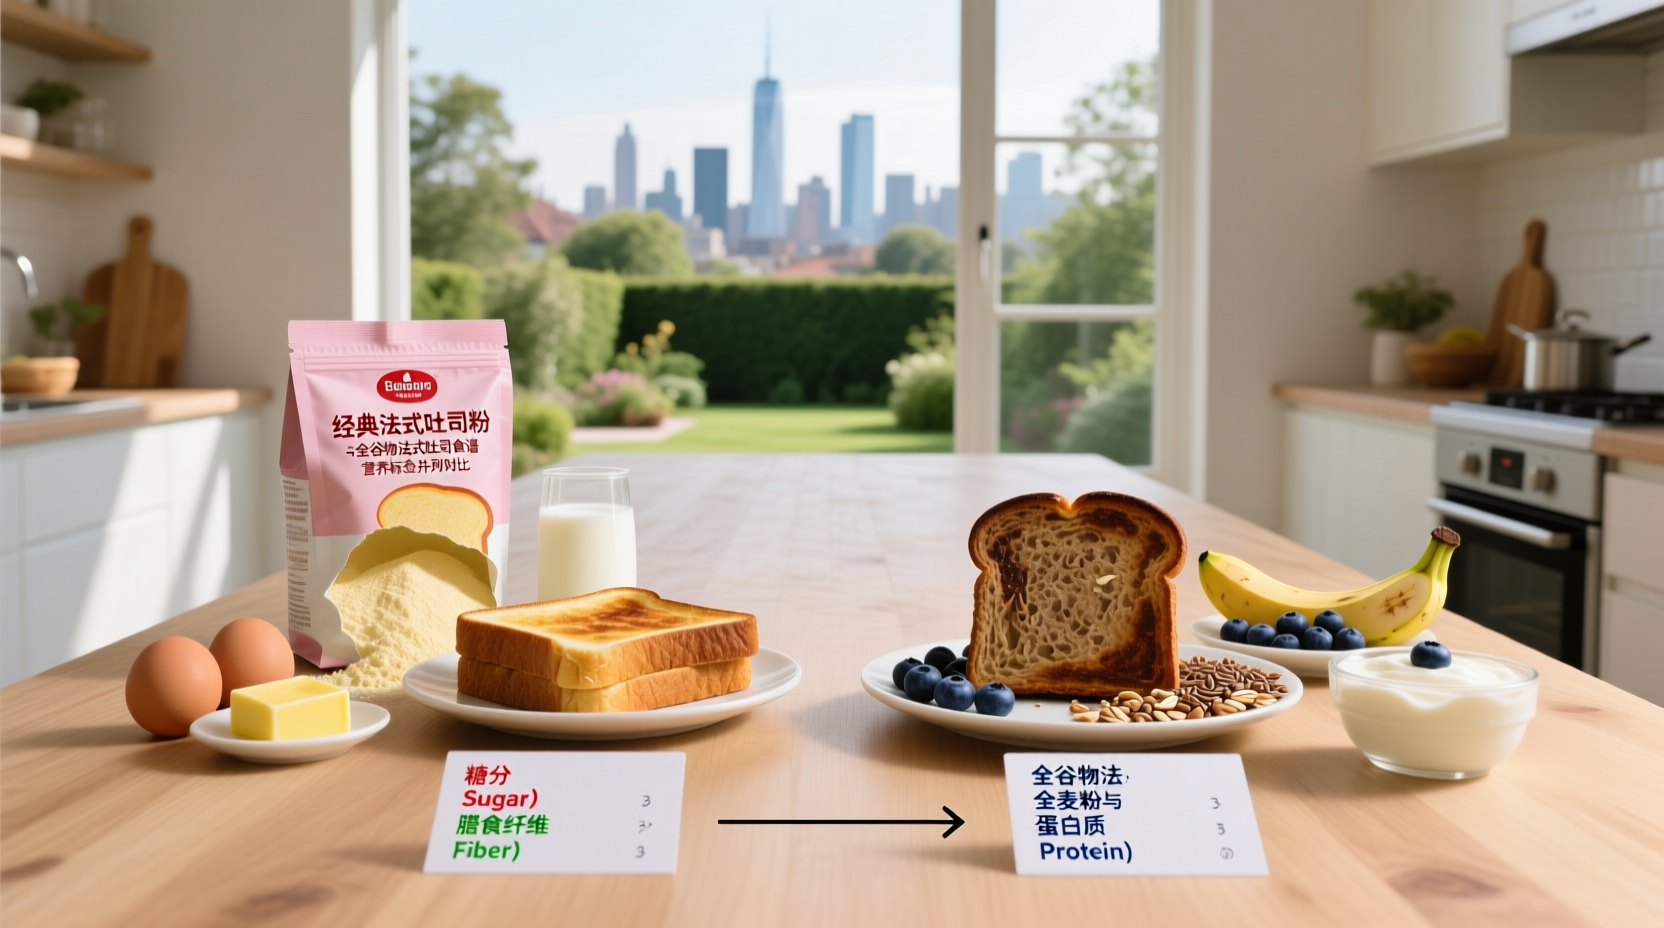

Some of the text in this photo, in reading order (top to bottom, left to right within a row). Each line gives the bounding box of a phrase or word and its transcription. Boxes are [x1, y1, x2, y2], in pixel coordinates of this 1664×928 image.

[331, 411, 490, 438] 经典法式吐司粉
[464, 764, 512, 786] 糖分
[461, 789, 539, 811] Sugar)
[1033, 789, 1122, 811] 全麦粉与
[1035, 814, 1106, 837] 蛋白质
[452, 840, 521, 863] Fiber)
[1039, 841, 1133, 865] Protein)
